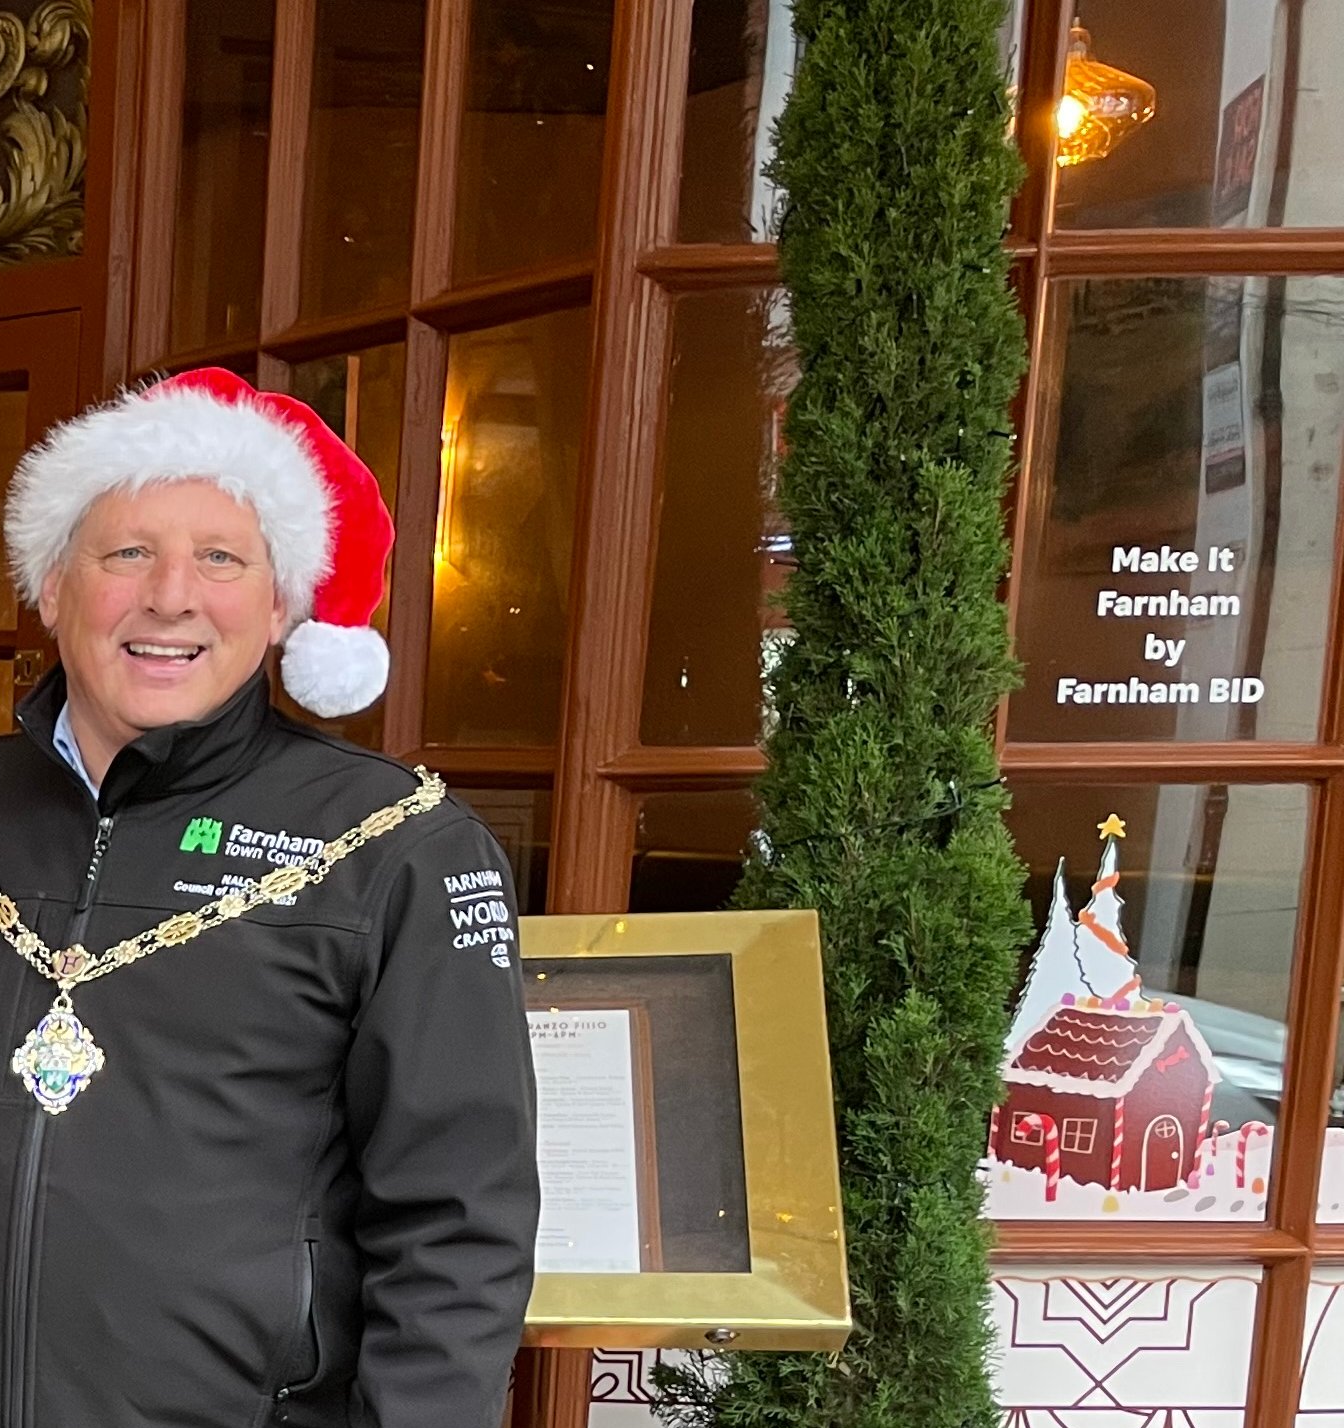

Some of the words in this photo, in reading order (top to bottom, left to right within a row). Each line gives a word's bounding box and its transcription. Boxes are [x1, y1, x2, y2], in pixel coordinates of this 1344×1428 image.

[1112, 546, 1199, 573] Make
[1208, 547, 1234, 572] It
[1097, 590, 1240, 616] Farnham
[1144, 634, 1186, 667] by
[1057, 677, 1199, 704] Farnham
[1209, 678, 1265, 703] BID
[229, 824, 325, 855] Farnham
[266, 848, 321, 870] Counil
[452, 927, 498, 949] CRAFT
